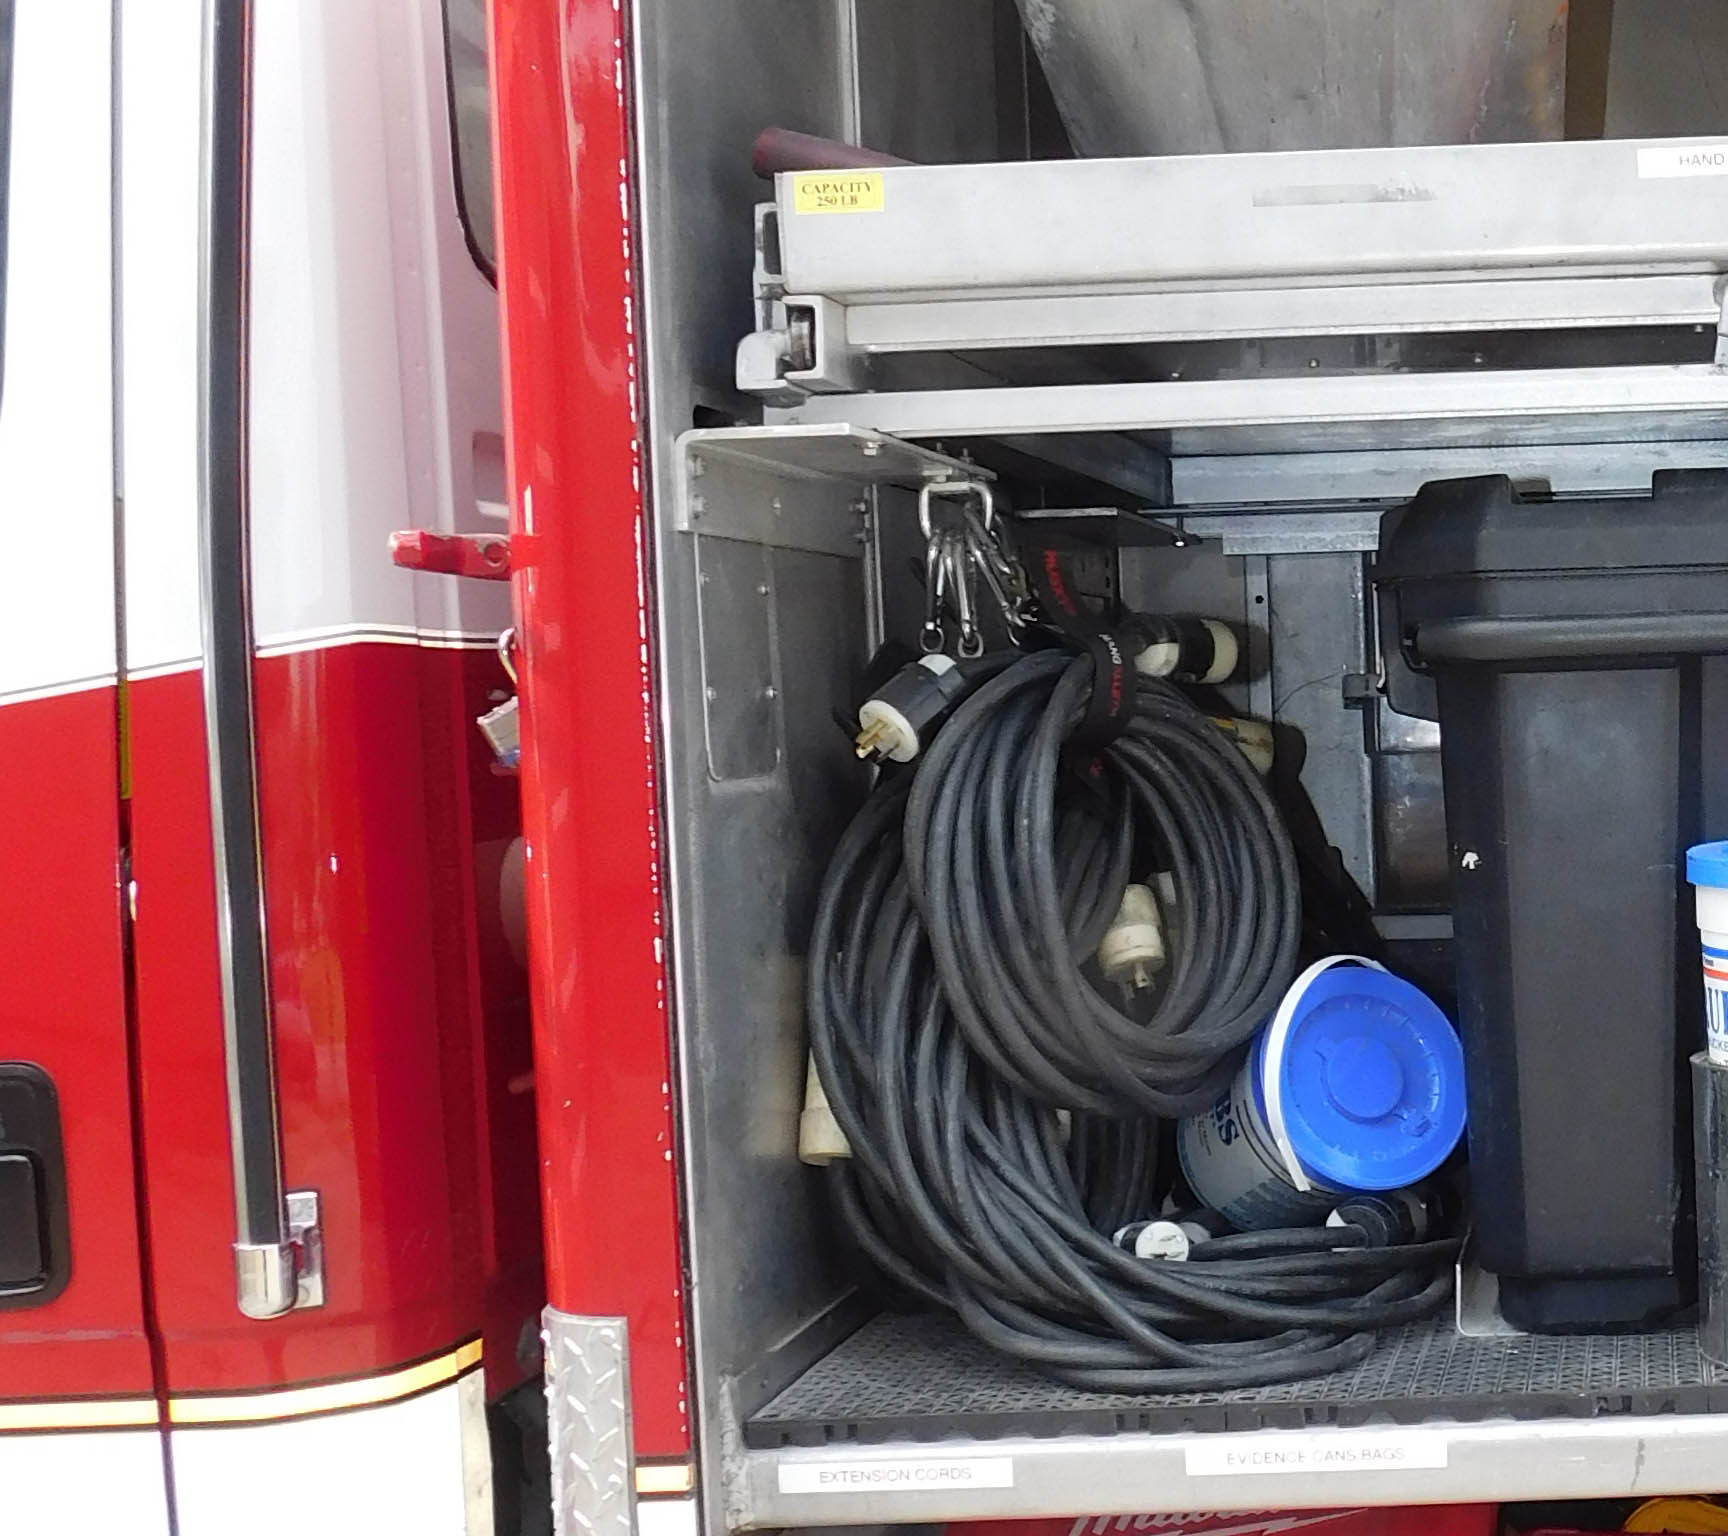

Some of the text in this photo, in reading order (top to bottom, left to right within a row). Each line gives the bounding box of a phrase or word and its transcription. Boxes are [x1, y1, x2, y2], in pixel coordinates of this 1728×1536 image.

[1678, 153, 1725, 167] HAND
[801, 181, 871, 195] CAPACITY
[816, 194, 859, 207] 250 LB
[1226, 1451, 1305, 1465] EVIDENCE
[818, 1467, 973, 1484] EXTENSION CORDS
